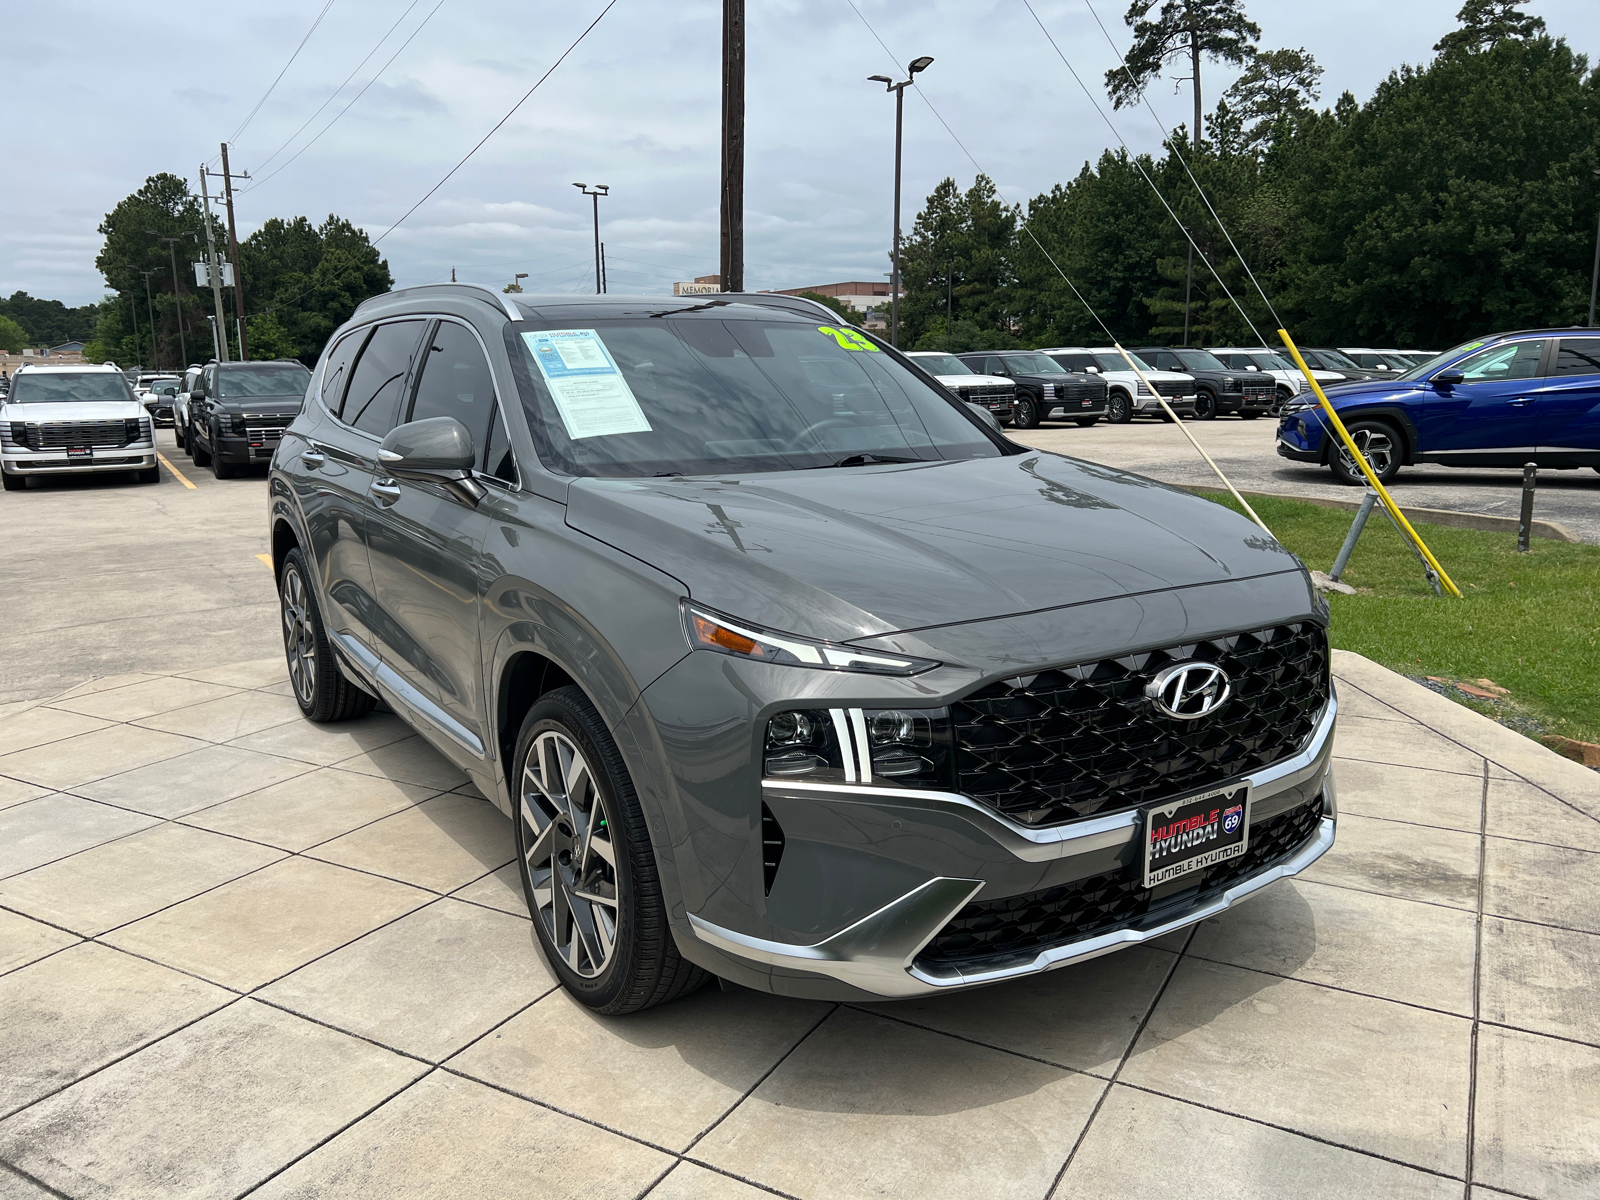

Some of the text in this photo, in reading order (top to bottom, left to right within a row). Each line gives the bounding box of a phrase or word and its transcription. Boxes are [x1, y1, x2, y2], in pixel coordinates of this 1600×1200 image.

[682, 286, 720, 295] MEMORIA
[818, 326, 881, 352] 23
[1150, 808, 1220, 844] HUMBLE
[1224, 815, 1239, 830] 69
[1150, 822, 1218, 861] HYUNDAI
[1148, 843, 1244, 886] HUMBLE HYUNDAI
